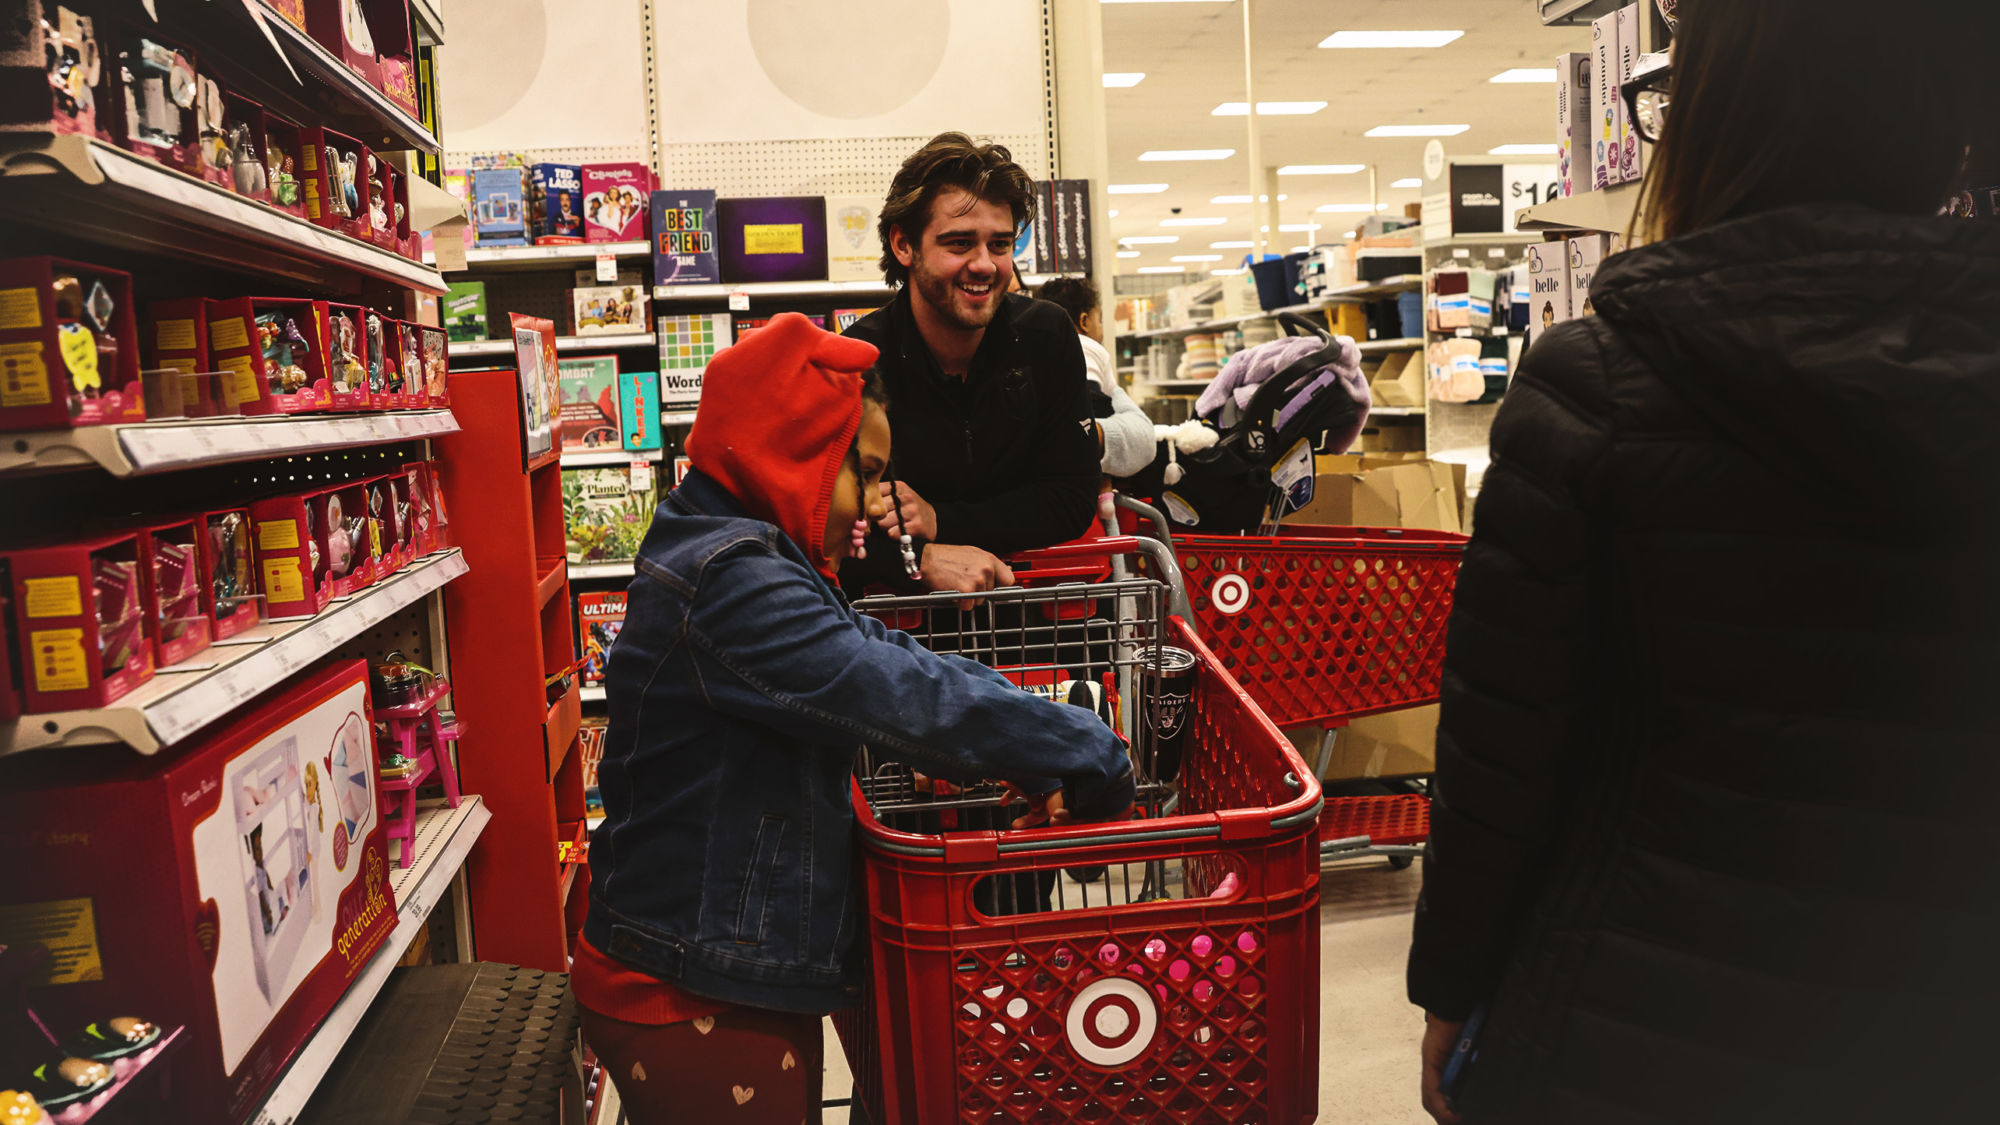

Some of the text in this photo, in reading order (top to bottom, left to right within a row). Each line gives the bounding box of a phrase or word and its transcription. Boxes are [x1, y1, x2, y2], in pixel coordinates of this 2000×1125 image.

[1623, 45, 1631, 81] belle
[554, 167, 574, 180] TED
[548, 176, 581, 190] LASSO
[667, 210, 701, 230] BEST
[660, 232, 711, 253] FRIEND
[1535, 277, 1559, 293] belle
[1576, 272, 1592, 289] bell
[666, 374, 702, 388] Word
[587, 482, 625, 494] Planted
[603, 594, 624, 603] UNO
[337, 893, 387, 961] generation
